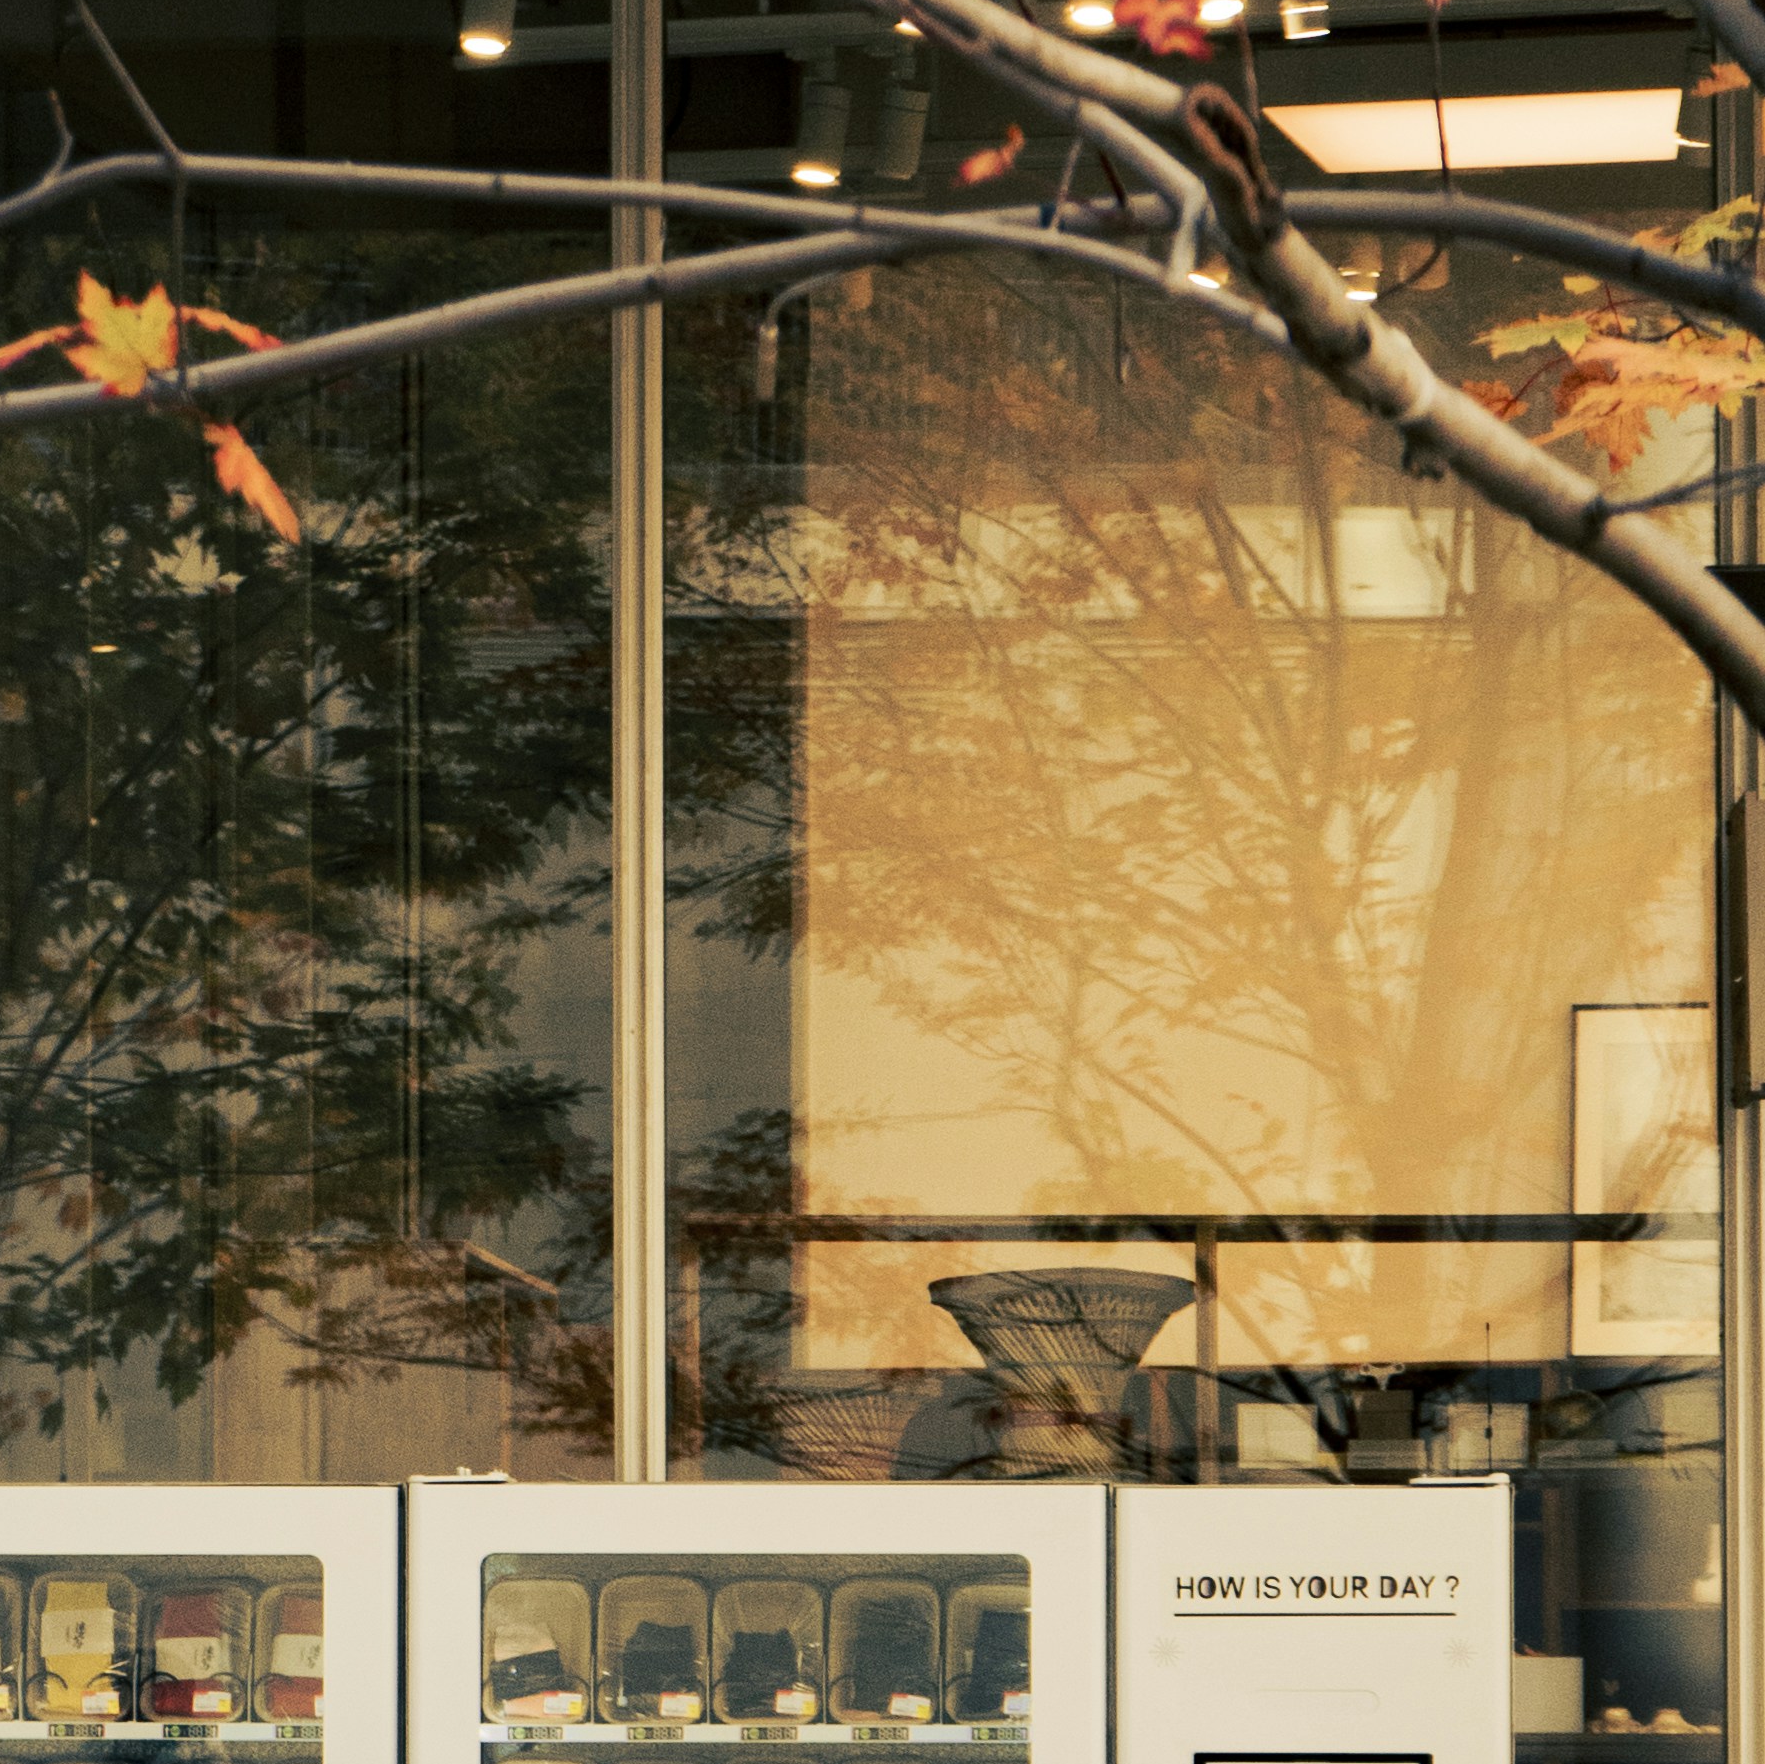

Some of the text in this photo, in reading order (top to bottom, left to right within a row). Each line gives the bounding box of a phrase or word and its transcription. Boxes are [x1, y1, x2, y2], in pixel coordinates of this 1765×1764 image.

[1175, 1574, 1461, 1599] HOW IS YOUR DAY ?
